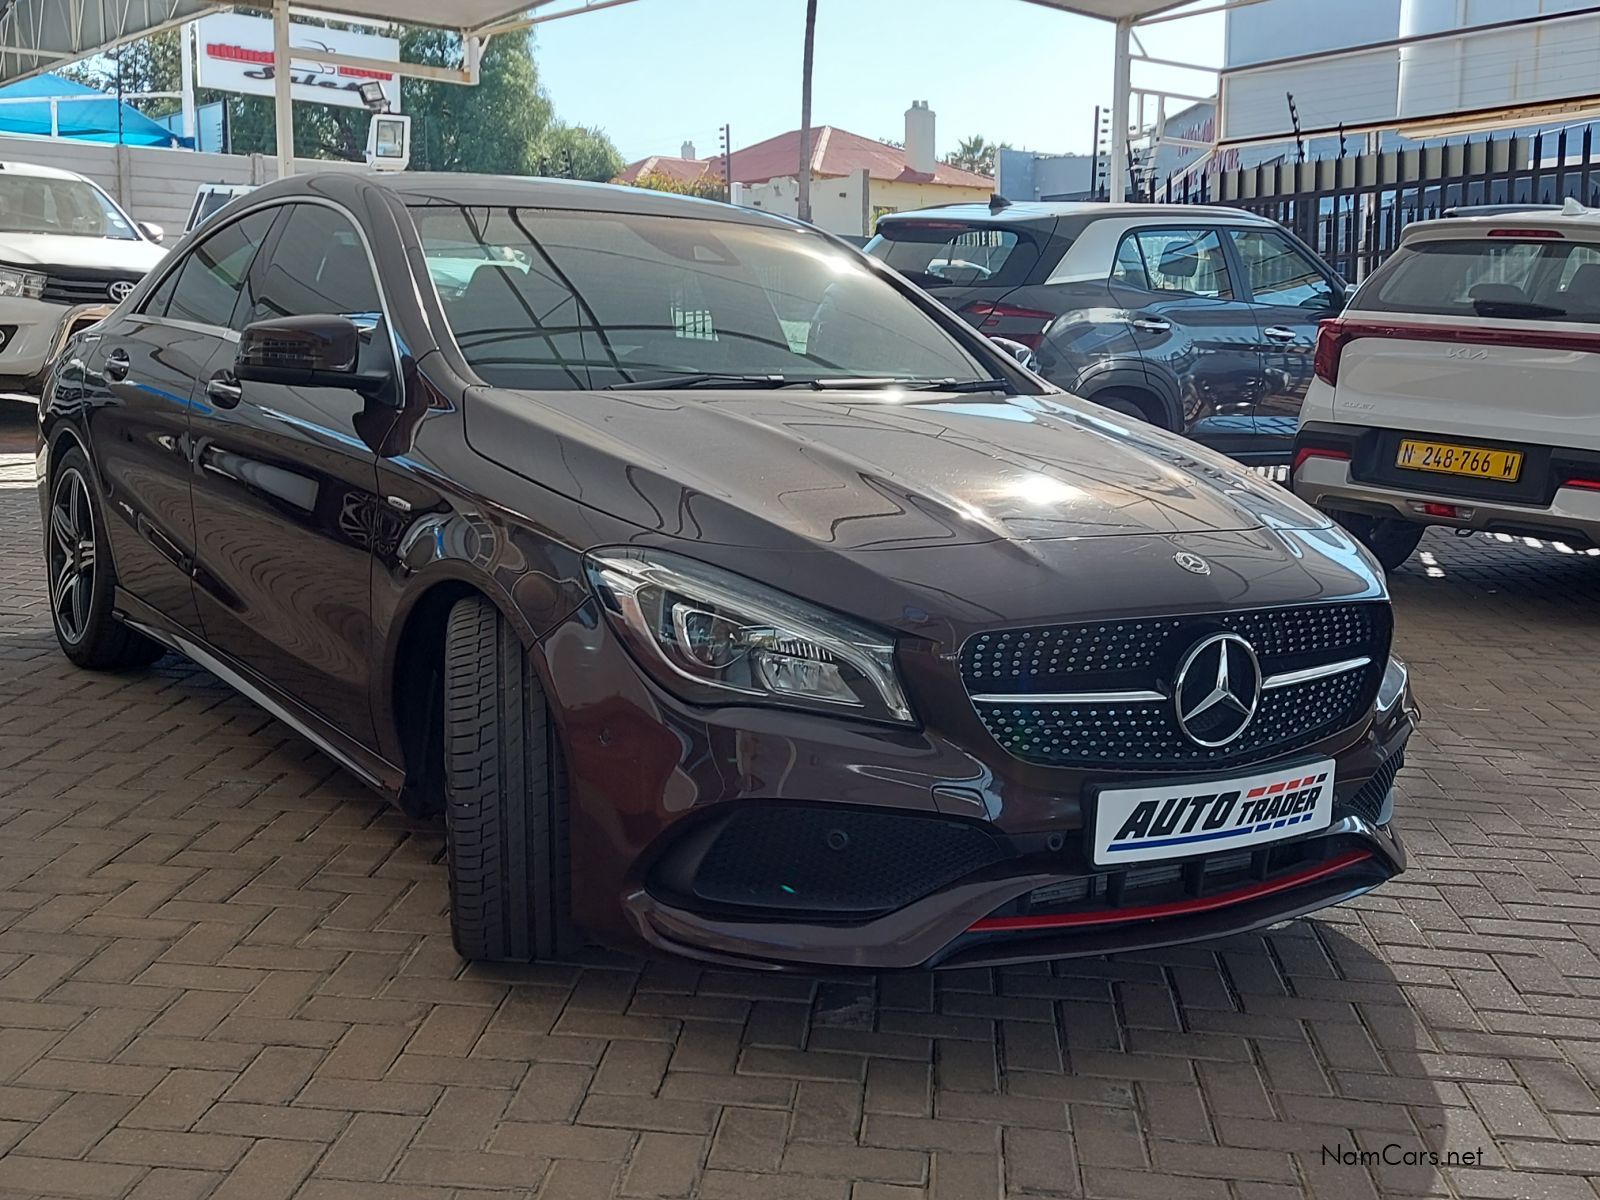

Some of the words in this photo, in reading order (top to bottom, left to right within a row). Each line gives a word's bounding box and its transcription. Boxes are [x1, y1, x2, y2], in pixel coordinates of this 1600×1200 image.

[1447, 348, 1489, 360] KIA
[1402, 443, 1415, 464] N
[1422, 446, 1491, 473] 248-766
[1502, 455, 1516, 476] W
[1113, 791, 1242, 841] AUTO
[1235, 786, 1323, 826] TRADER
